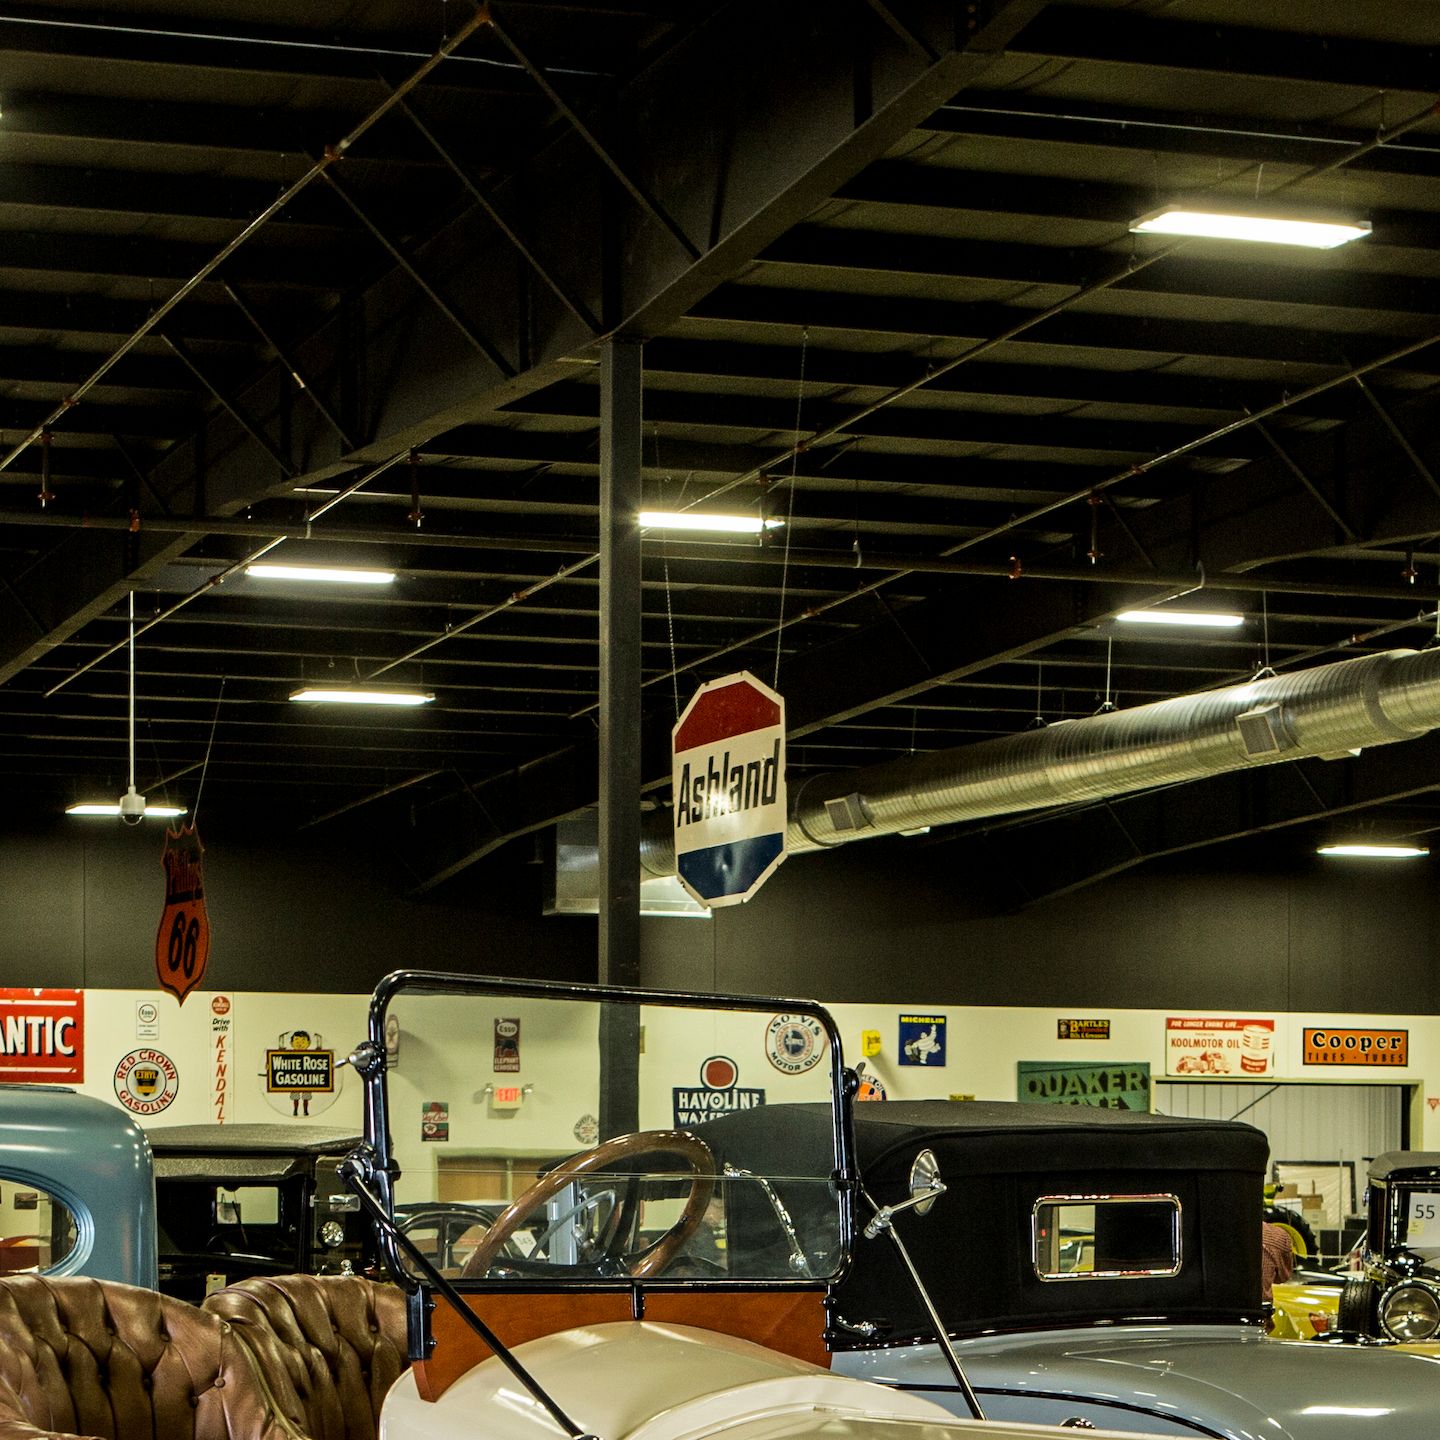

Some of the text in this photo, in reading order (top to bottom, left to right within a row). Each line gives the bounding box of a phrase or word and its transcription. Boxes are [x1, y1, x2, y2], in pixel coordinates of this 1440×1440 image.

[677, 738, 781, 828] Ashland
[168, 911, 200, 979] 66
[212, 1018, 231, 1026] Drive
[770, 1014, 821, 1036] ISO-VIS
[900, 1016, 945, 1024] MICHELIN
[1171, 1037, 1240, 1048] KOOLMOTOR OIL
[1312, 1031, 1403, 1052] Cooper
[273, 1056, 328, 1071] WHITE ROSE
[771, 1051, 819, 1071] MOTOR OIL
[1308, 1052, 1404, 1063] TIRES TUBES
[116, 1050, 176, 1081] RED CROWN
[136, 1070, 158, 1080] ETHYL
[276, 1072, 325, 1085] GASOLINE
[1024, 1070, 1148, 1098] QUAKER
[119, 1089, 174, 1113] GASOLINE
[497, 1088, 520, 1102] EXIT
[678, 1088, 760, 1109] HAVOLINE
[678, 1111, 707, 1126] WAX
[1415, 1204, 1435, 1219] 55
